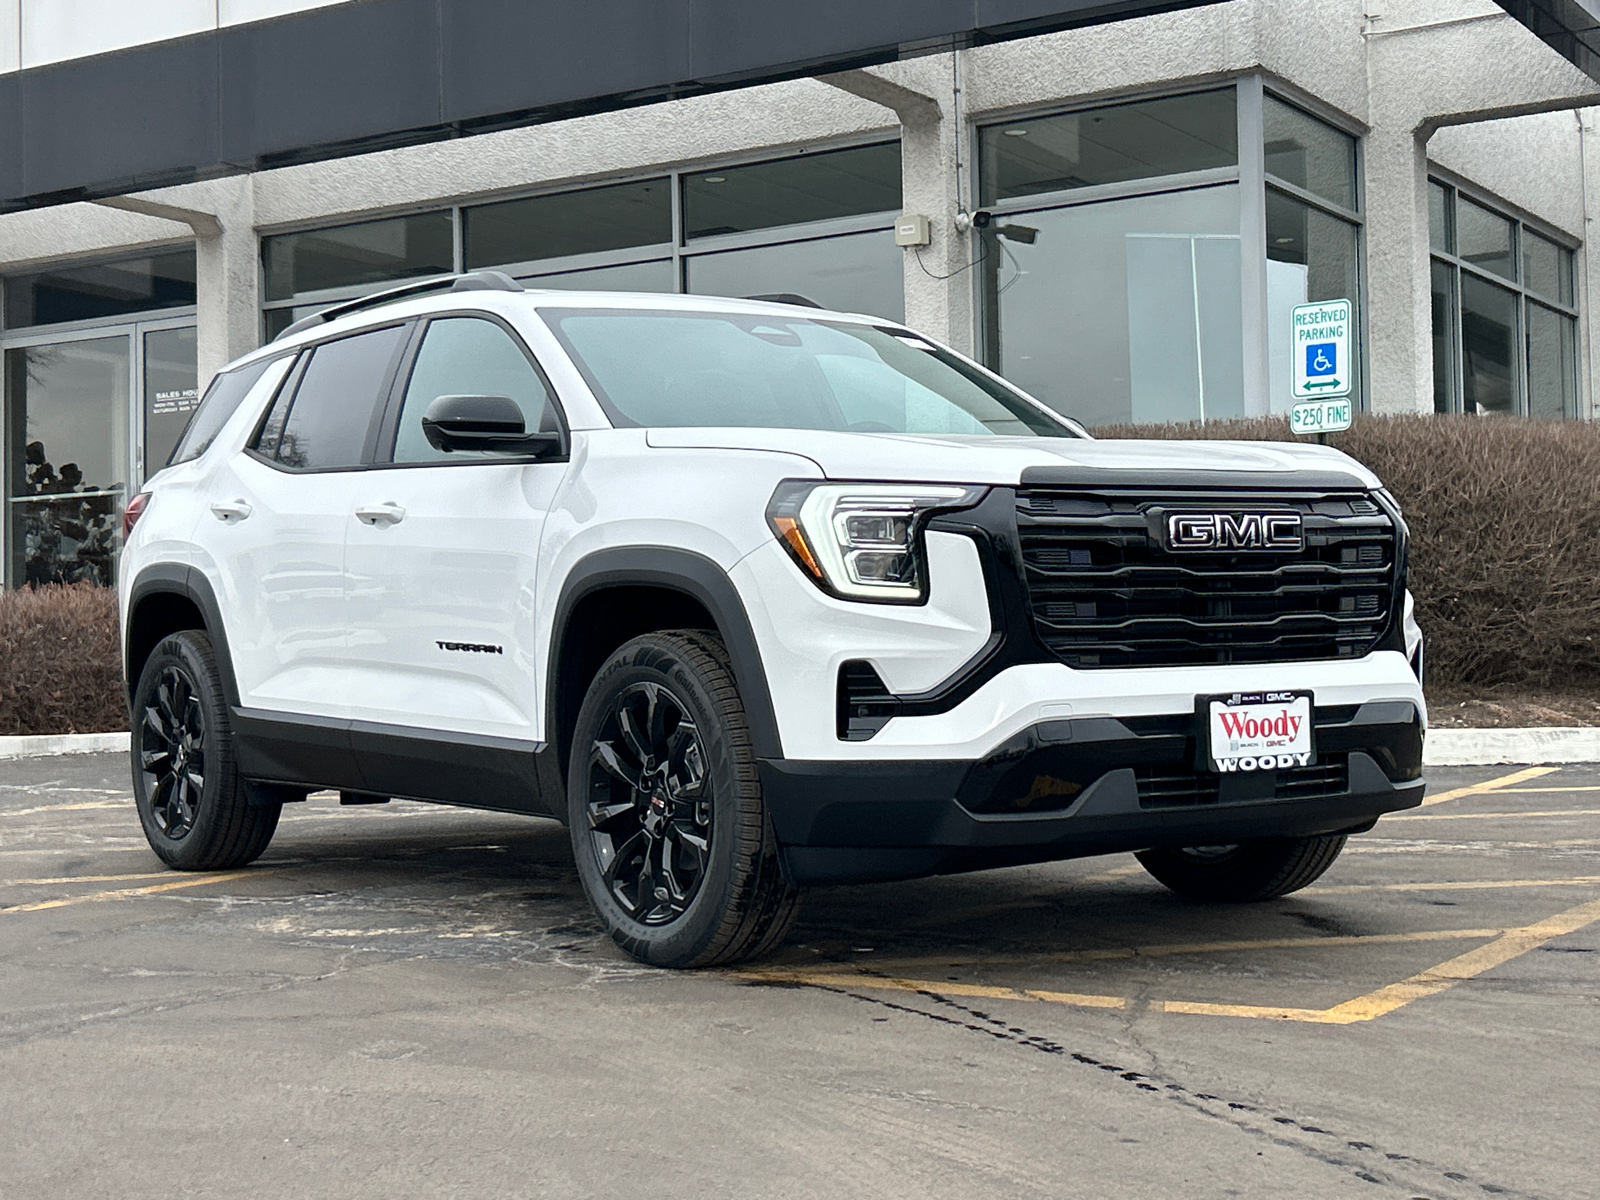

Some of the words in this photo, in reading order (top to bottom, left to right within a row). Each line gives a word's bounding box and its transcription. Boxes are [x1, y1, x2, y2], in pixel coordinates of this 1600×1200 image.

[1295, 308, 1346, 326] RESERVED
[1299, 325, 1343, 341] PARKING
[156, 390, 180, 399] SALES
[1294, 408, 1322, 426] $250
[1327, 405, 1349, 424] FINE
[1169, 514, 1302, 548] GMC
[435, 641, 503, 655] TERRAIN
[1266, 692, 1292, 702] GMC
[1218, 709, 1303, 743] Woody
[1266, 740, 1287, 748] GMC
[1215, 751, 1312, 773] WOODY
